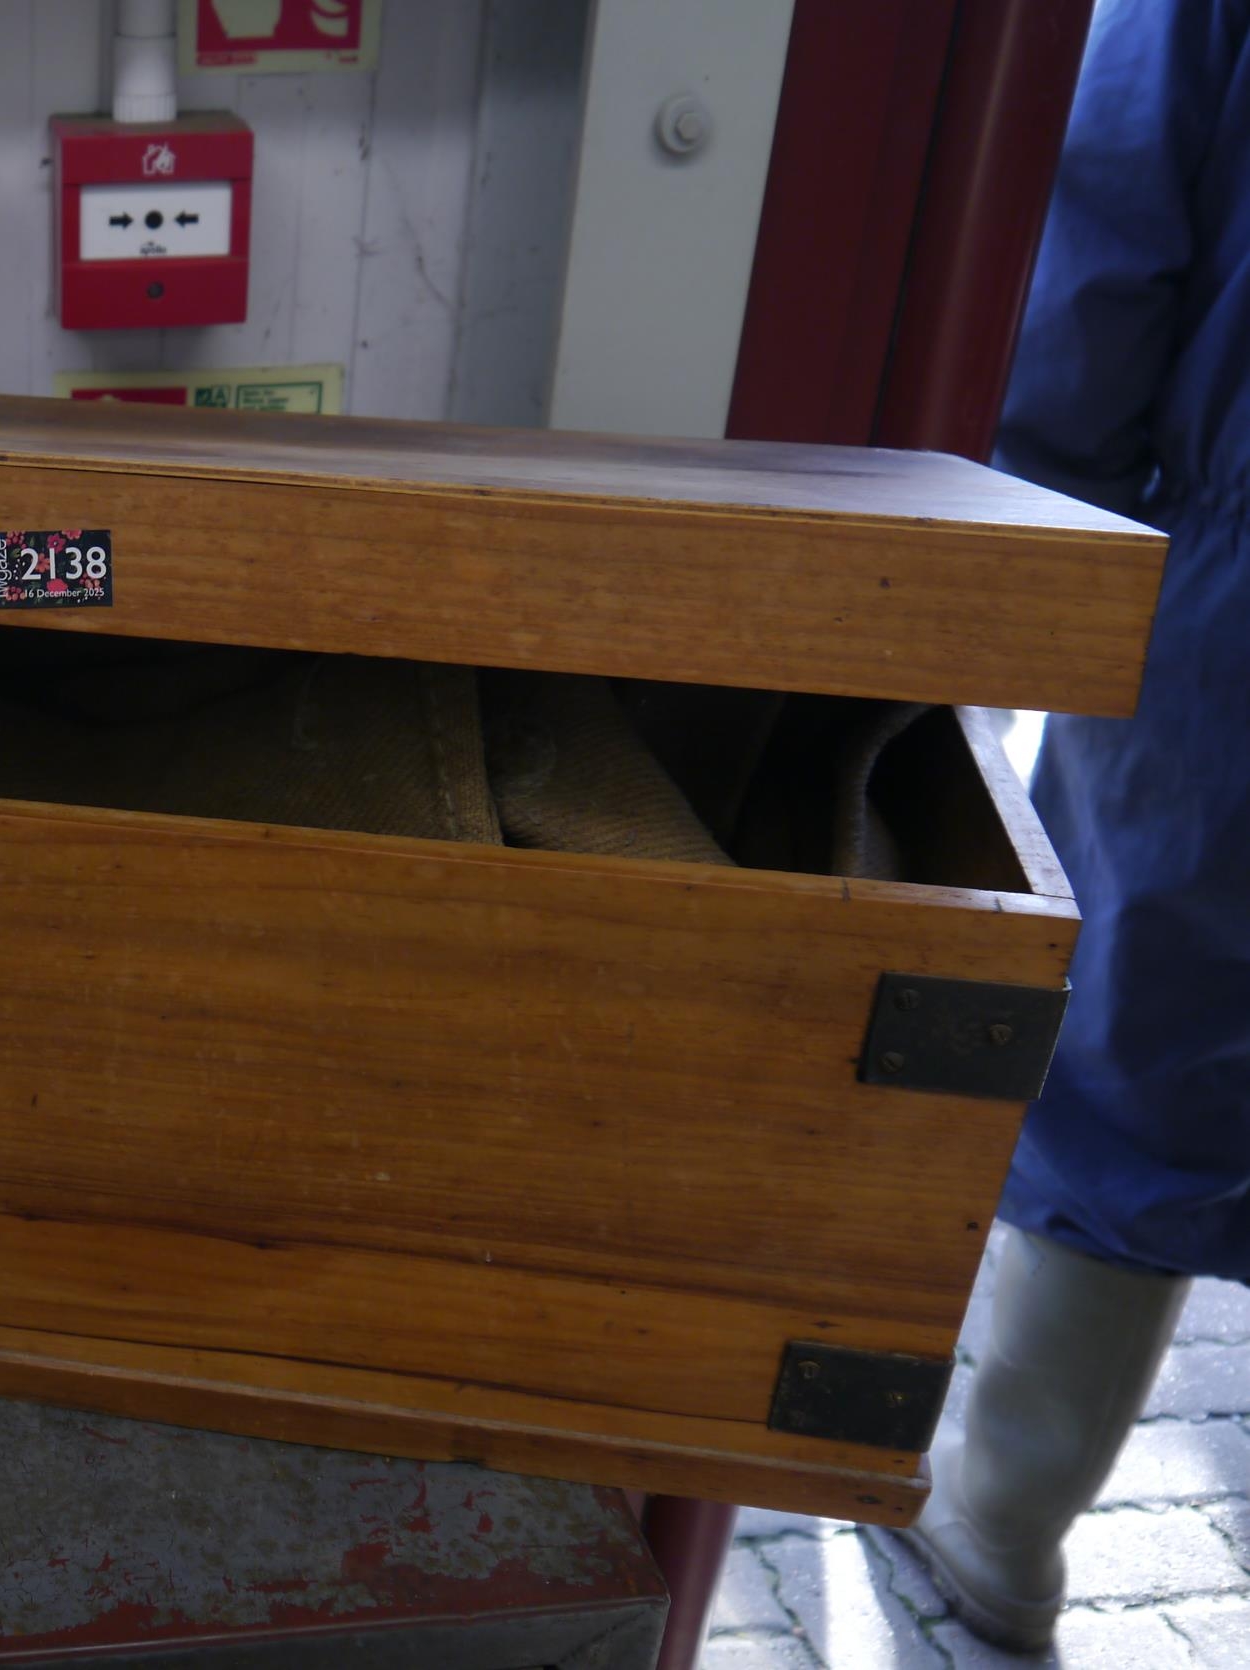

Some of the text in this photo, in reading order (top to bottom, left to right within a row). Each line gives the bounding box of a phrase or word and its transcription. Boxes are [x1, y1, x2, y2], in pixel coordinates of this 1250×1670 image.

[20, 546, 107, 580] 2138
[24, 587, 105, 598] 16 December 2025
